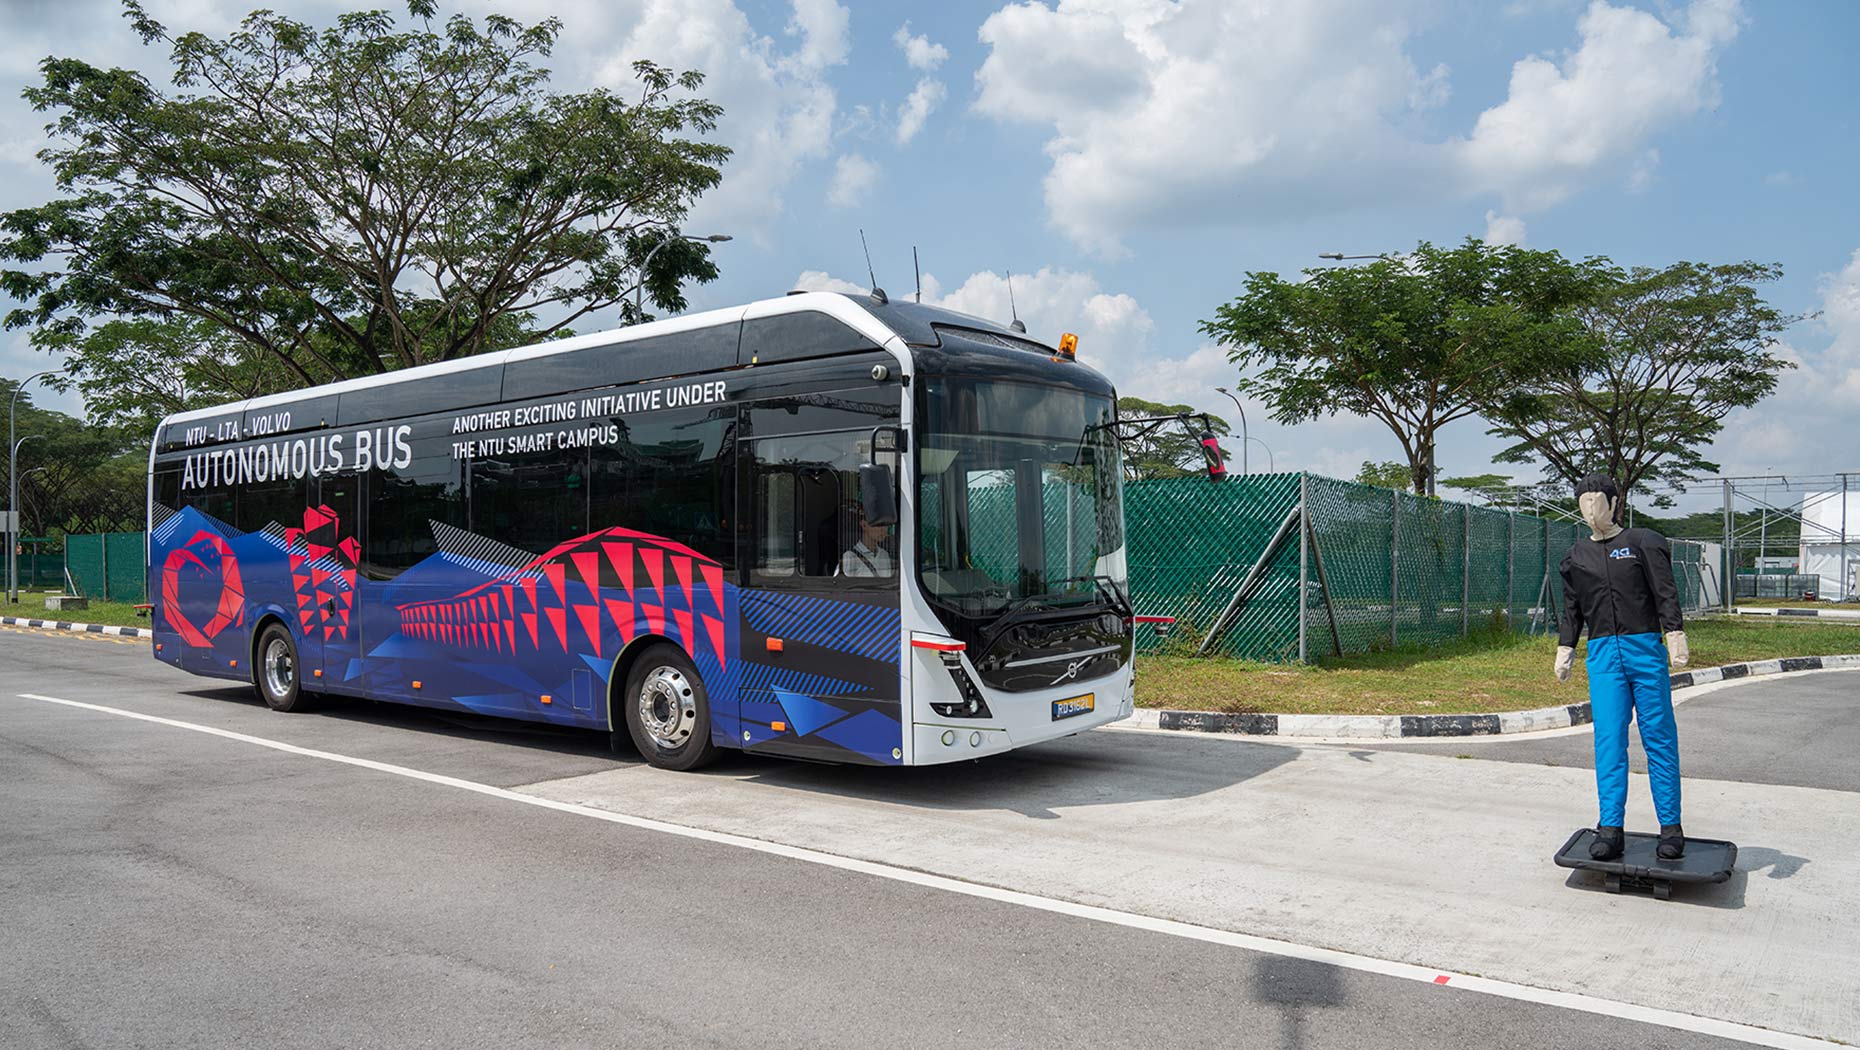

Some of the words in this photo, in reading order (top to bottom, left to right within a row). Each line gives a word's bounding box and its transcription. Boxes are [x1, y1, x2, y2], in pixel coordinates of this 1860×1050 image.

[185, 426, 208, 447] NTU
[217, 420, 239, 442] LTA
[252, 411, 291, 436] VOLVO
[452, 411, 510, 434] ANOTHER
[514, 402, 576, 427] EXCITING
[580, 389, 661, 418] INITIATIVE
[666, 380, 727, 407] UNDER
[181, 434, 344, 491] AUTONOMOUS
[355, 425, 413, 473] BUS
[452, 440, 475, 460] THE
[478, 436, 505, 457] NTU
[507, 432, 554, 454] SMART
[557, 425, 619, 450] CAMPUS
